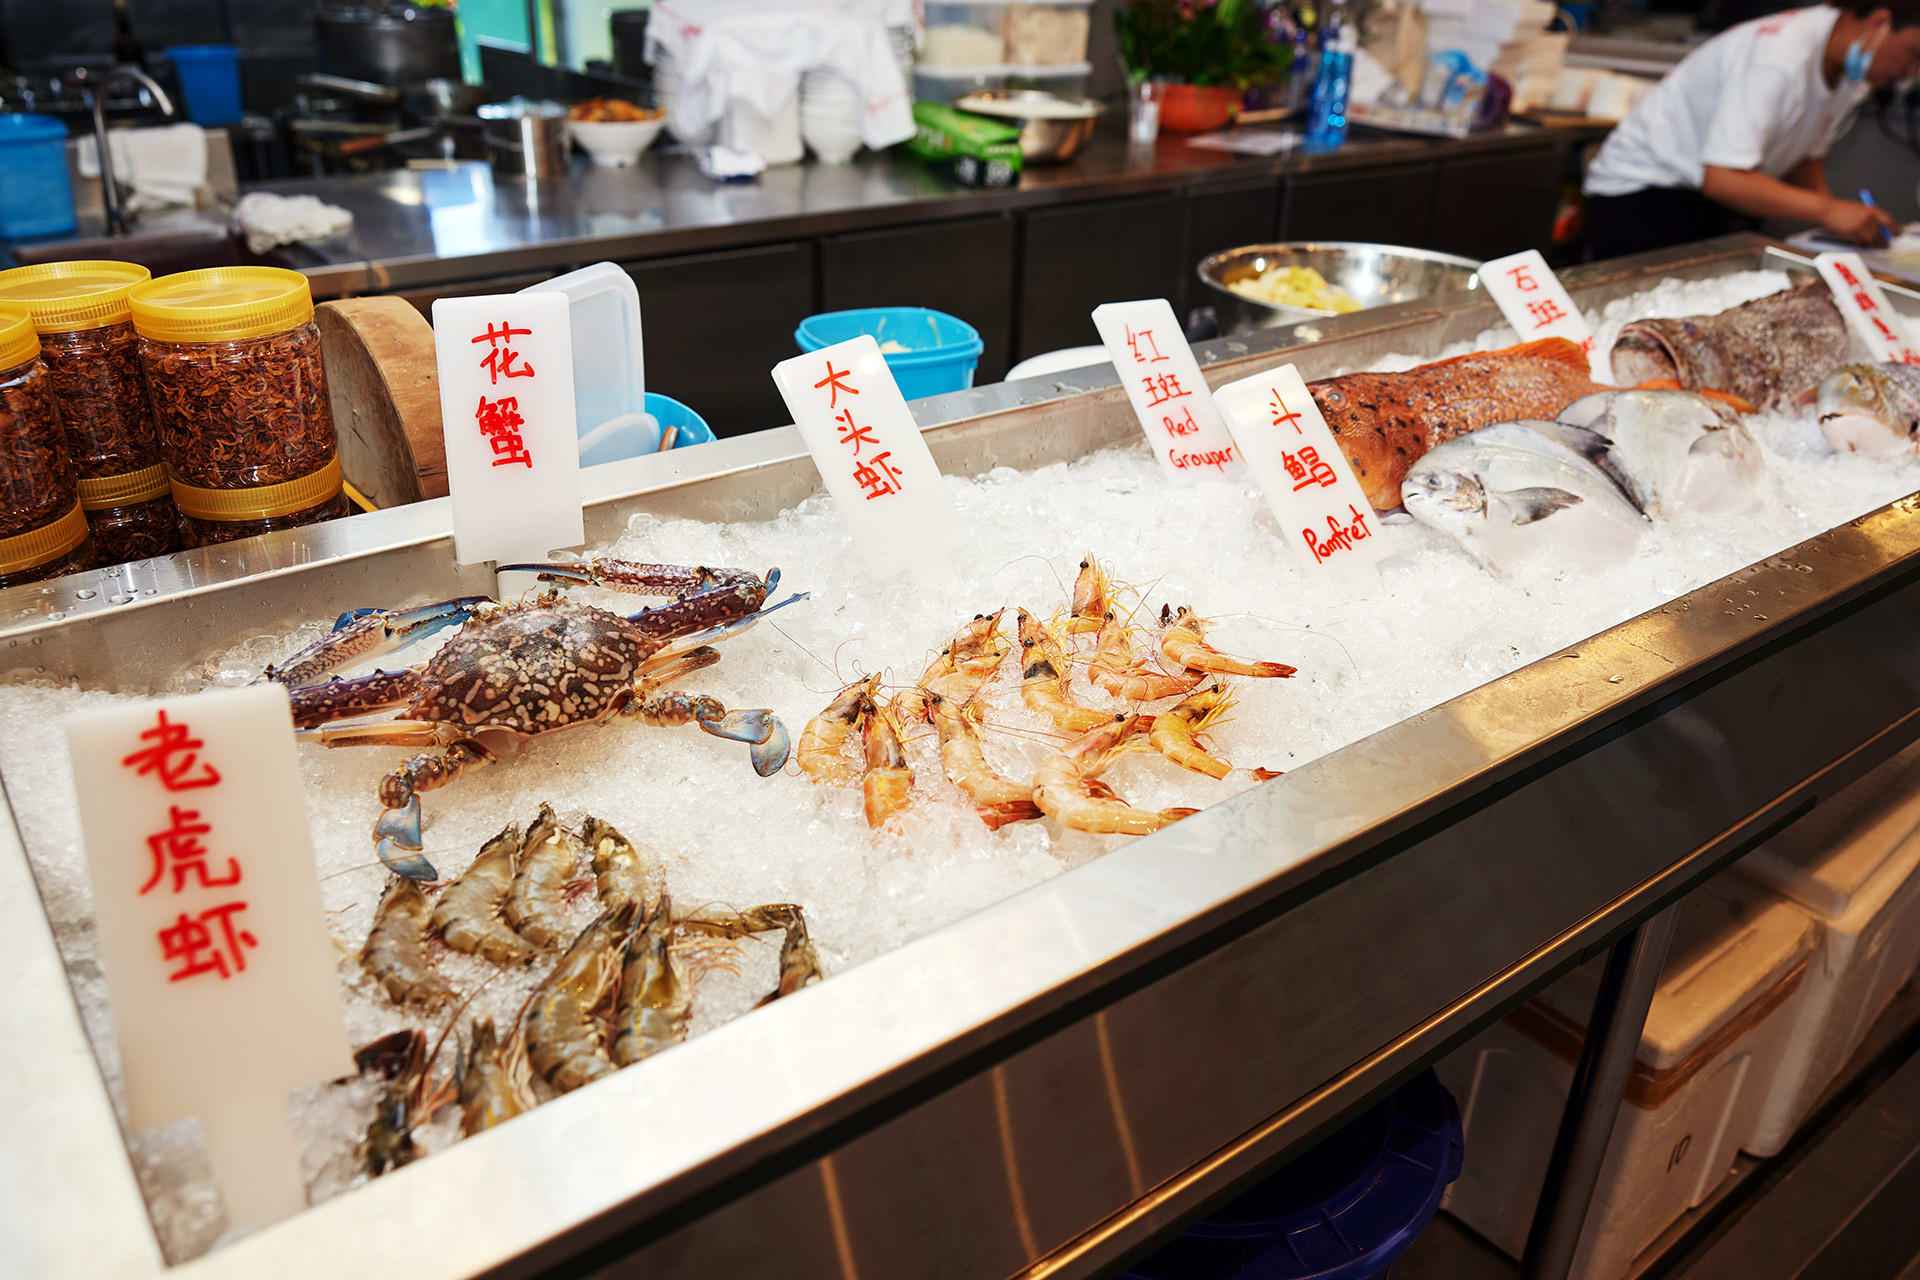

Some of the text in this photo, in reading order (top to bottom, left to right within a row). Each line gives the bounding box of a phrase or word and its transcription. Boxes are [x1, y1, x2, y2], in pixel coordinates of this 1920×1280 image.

[471, 320, 535, 469] 花蟹
[814, 360, 903, 501] 大头虾
[1163, 407, 1199, 439] Red
[1270, 387, 1338, 492] 斗鲳
[1169, 447, 1233, 473] Grouper
[1302, 504, 1374, 565] Pomfret
[121, 709, 259, 983] 老虎虾
